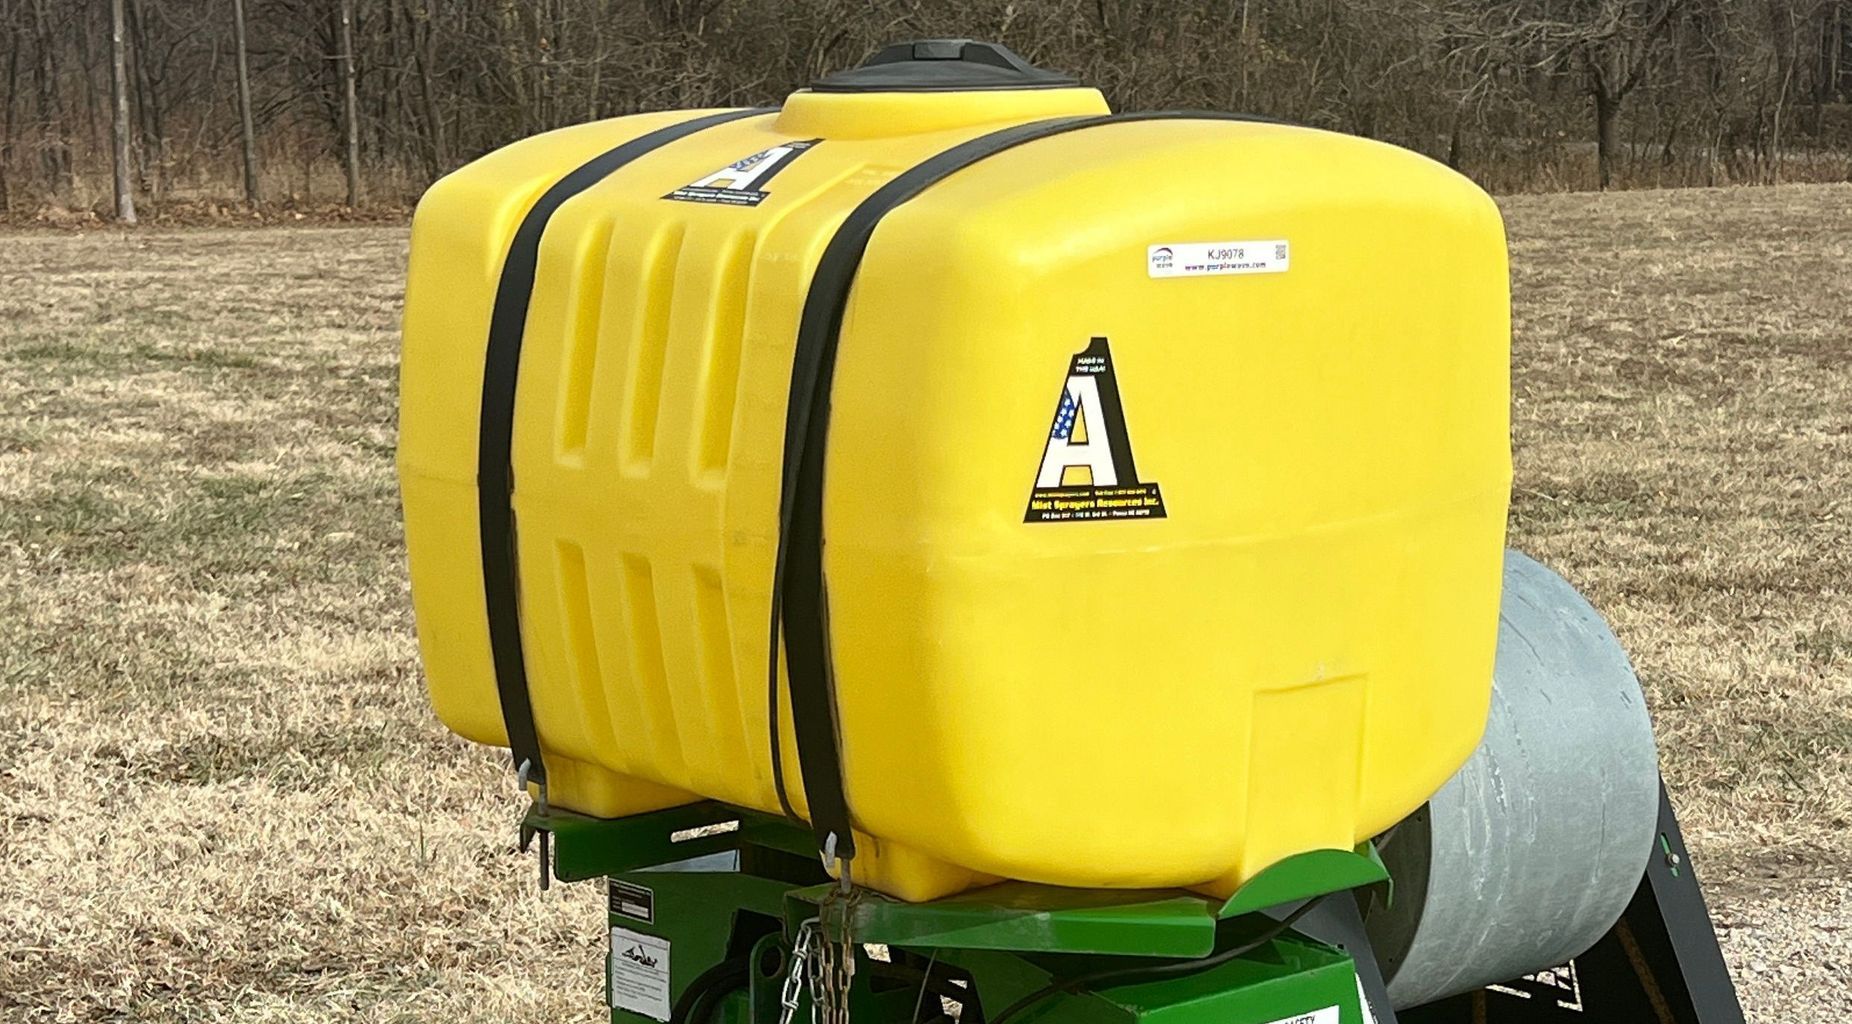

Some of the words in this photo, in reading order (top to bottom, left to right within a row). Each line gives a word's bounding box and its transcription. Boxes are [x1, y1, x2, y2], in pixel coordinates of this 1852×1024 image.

[1207, 249, 1245, 260] KJ9078
[1184, 261, 1266, 271] www.purplewave.com
[1032, 500, 1052, 510] Mist
[1054, 500, 1095, 511] Sprayers
[1097, 498, 1142, 508] Resources
